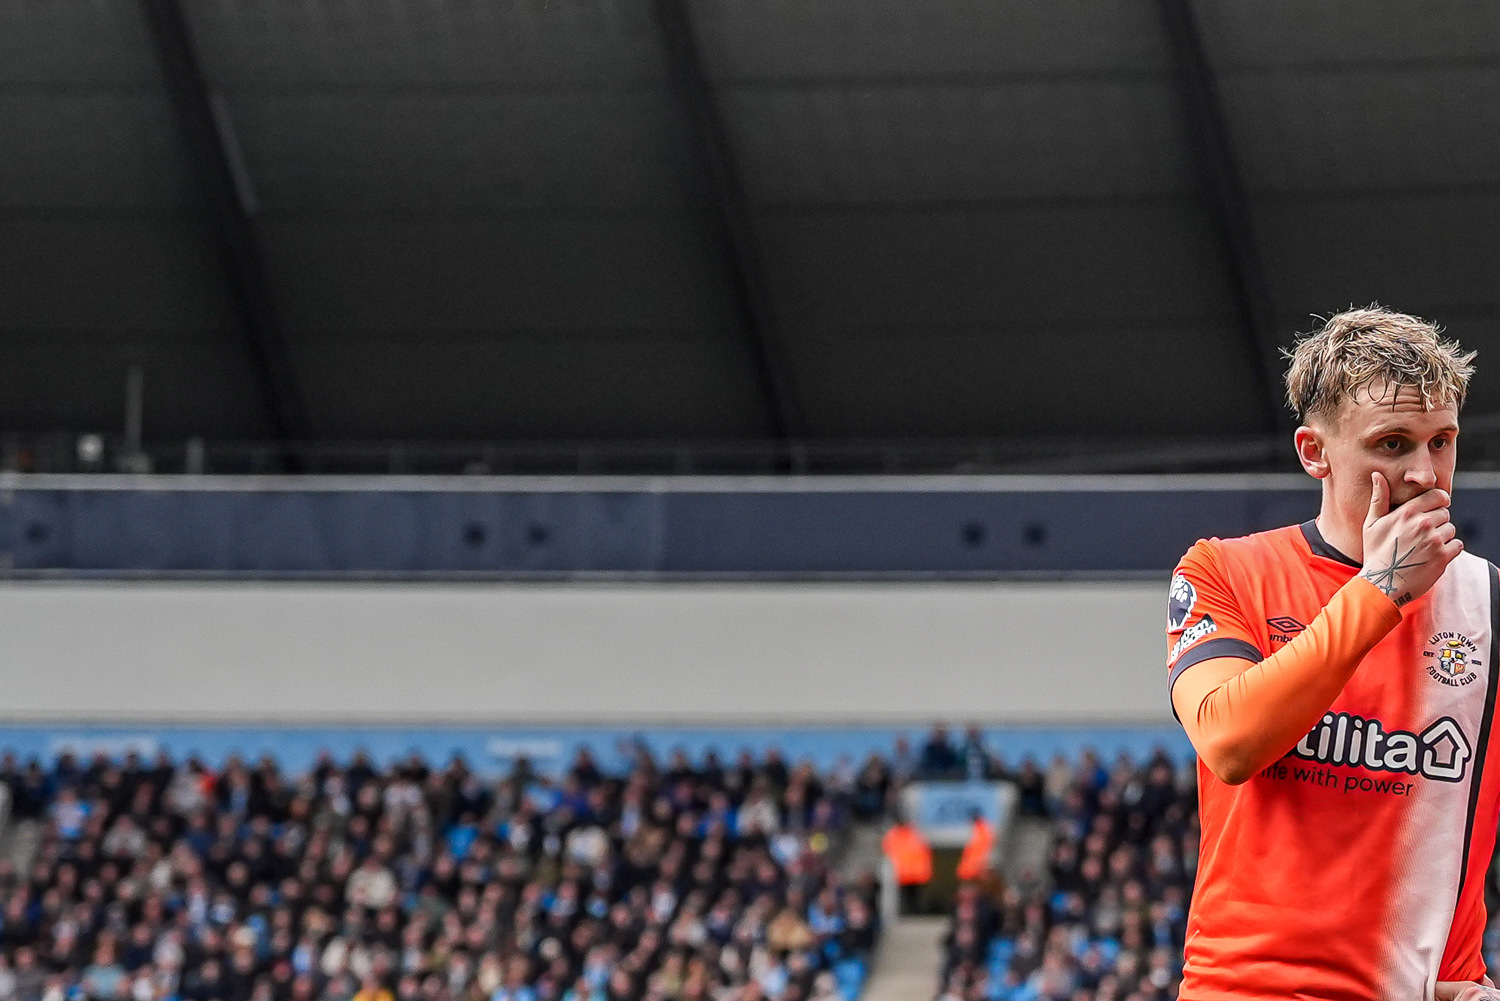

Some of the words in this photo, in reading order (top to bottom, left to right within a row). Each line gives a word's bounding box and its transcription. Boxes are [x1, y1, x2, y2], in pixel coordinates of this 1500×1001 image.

[1428, 632, 1454, 645] LUTON
[1457, 633, 1477, 652] TOWN
[1426, 665, 1459, 687] FOOTBALL
[1460, 672, 1477, 686] CLUB
[1296, 714, 1417, 771] tilita
[1294, 766, 1338, 788] with
[1344, 776, 1414, 796] power
